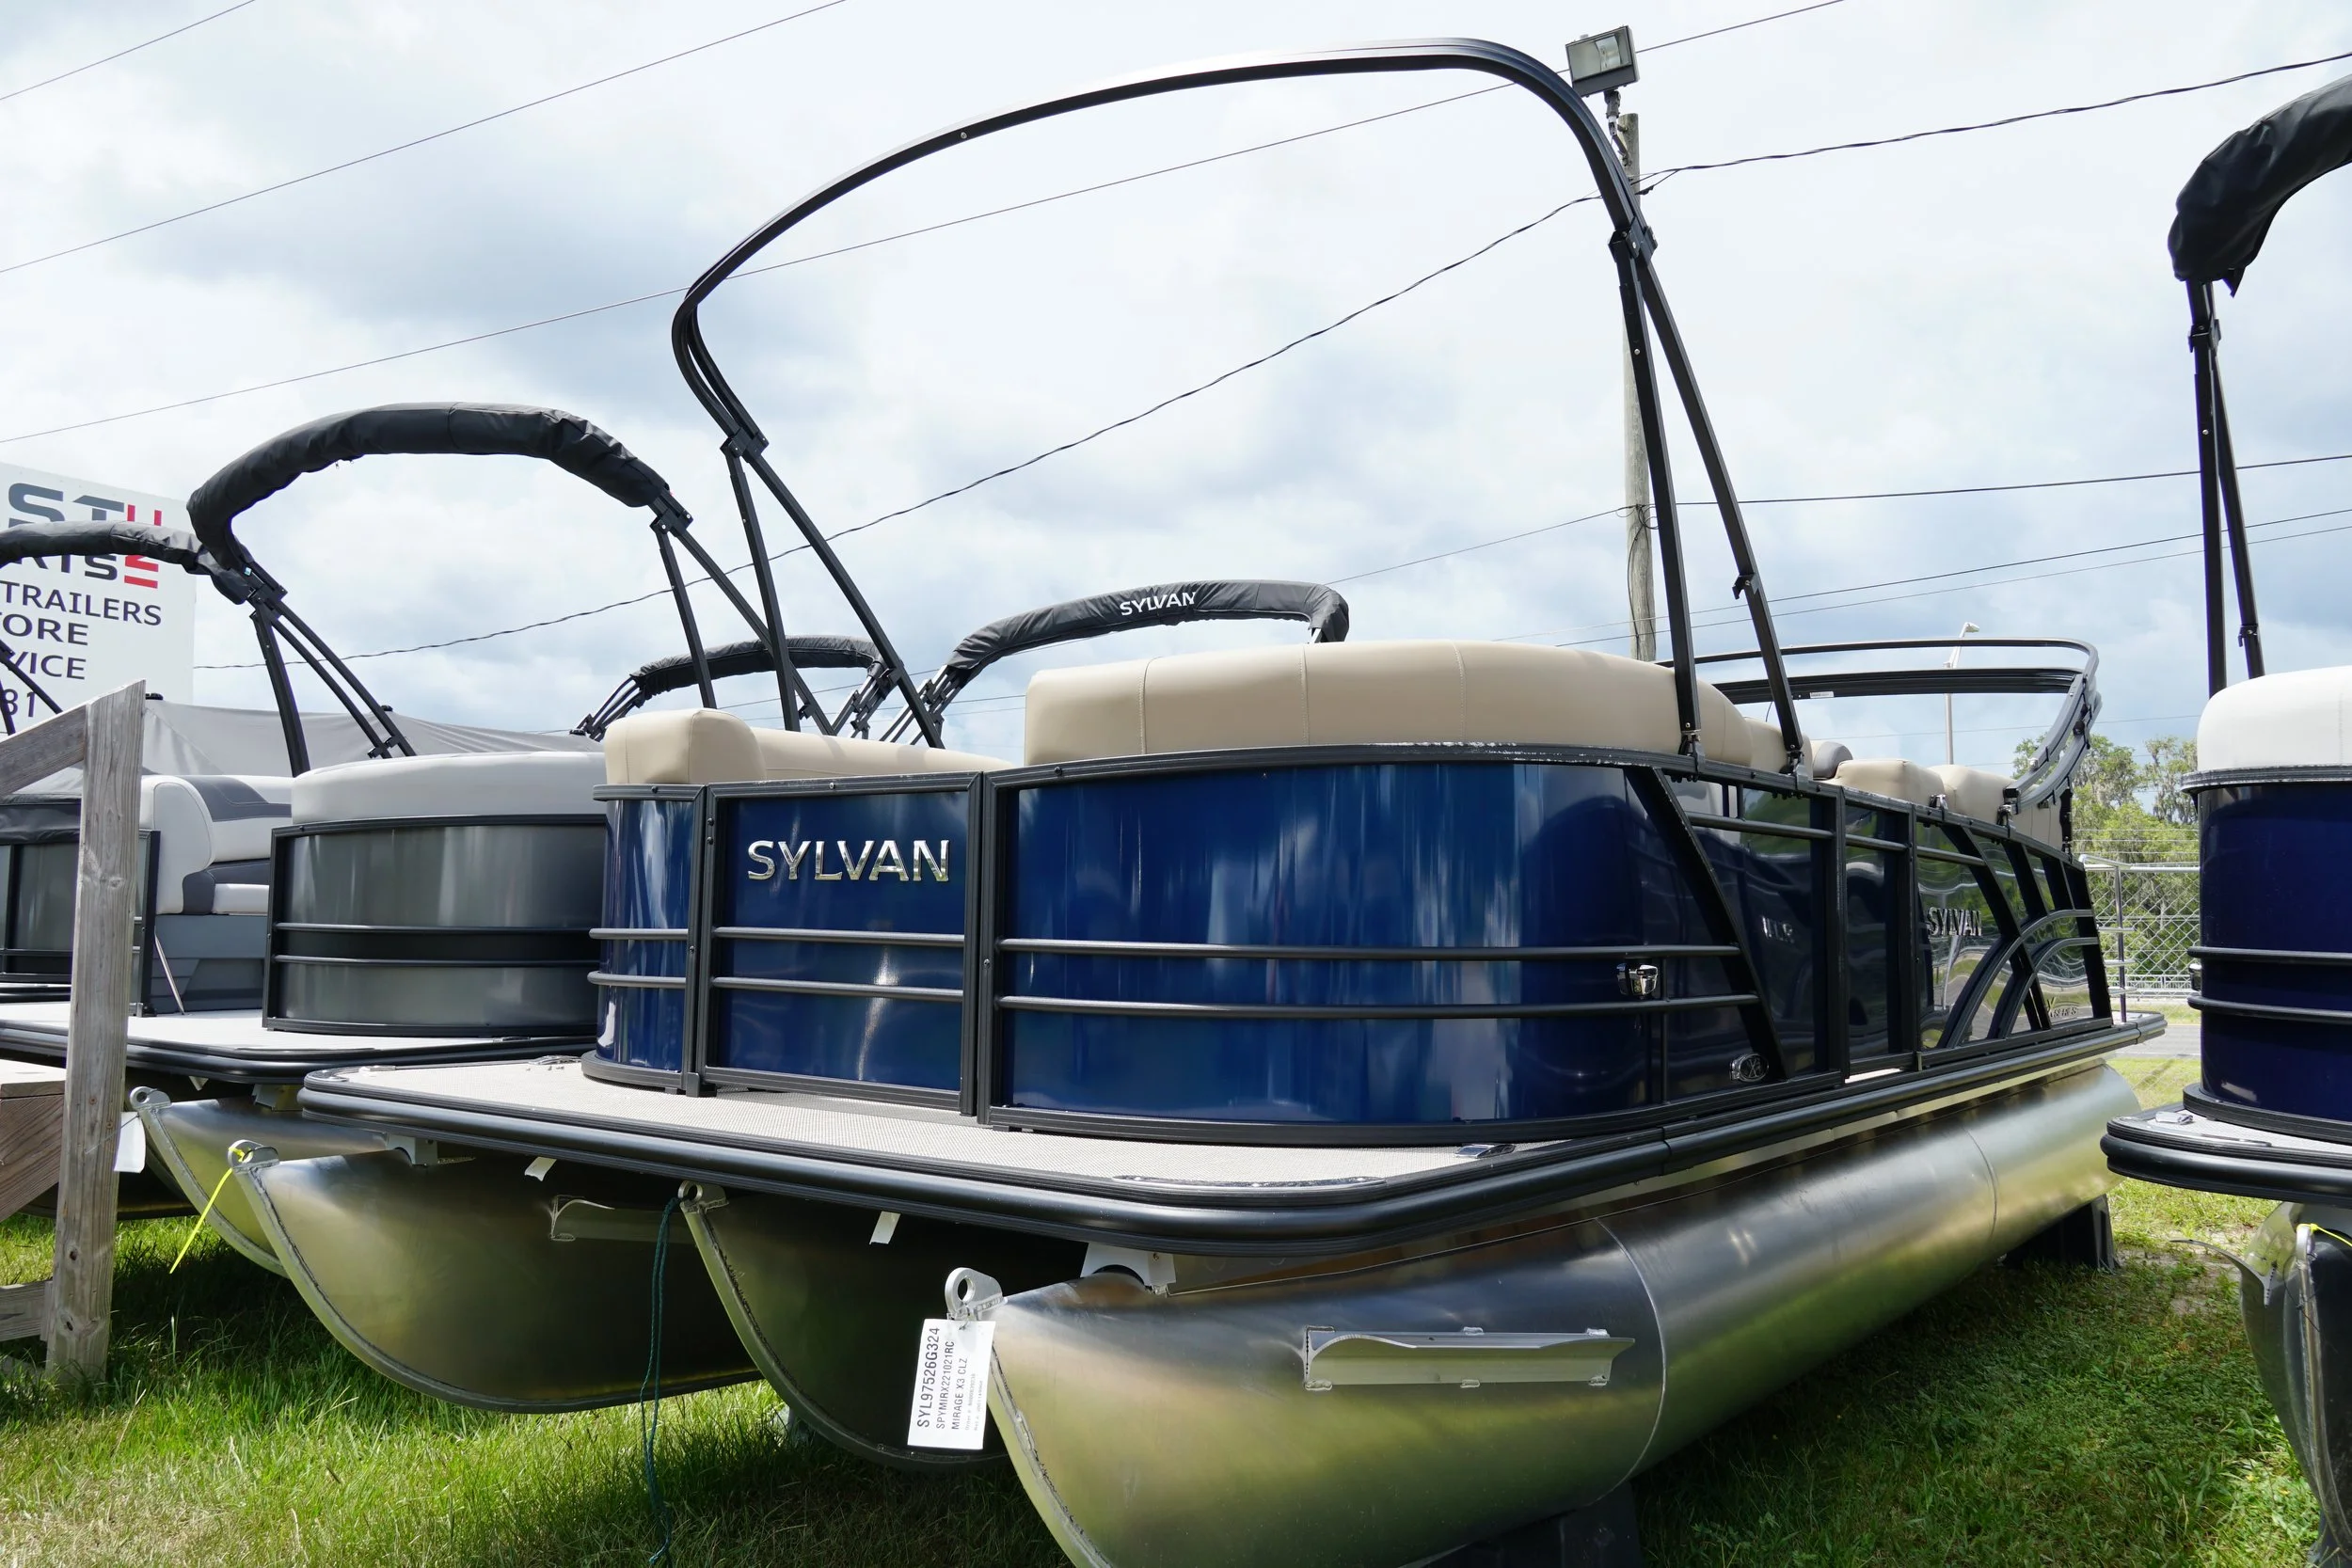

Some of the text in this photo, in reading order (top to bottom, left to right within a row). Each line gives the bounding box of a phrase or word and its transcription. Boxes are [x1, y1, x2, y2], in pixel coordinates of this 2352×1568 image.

[0, 580, 162, 626] TRAILERS
[1120, 592, 1197, 616] SYLVAN
[0, 612, 88, 646] ORE
[747, 839, 949, 881] SYLVAN
[1927, 907, 1982, 936] SYLVAN
[917, 1327, 940, 1428] SYL97526G324
[951, 1357, 968, 1430] MIRAGE X3 CLZ
